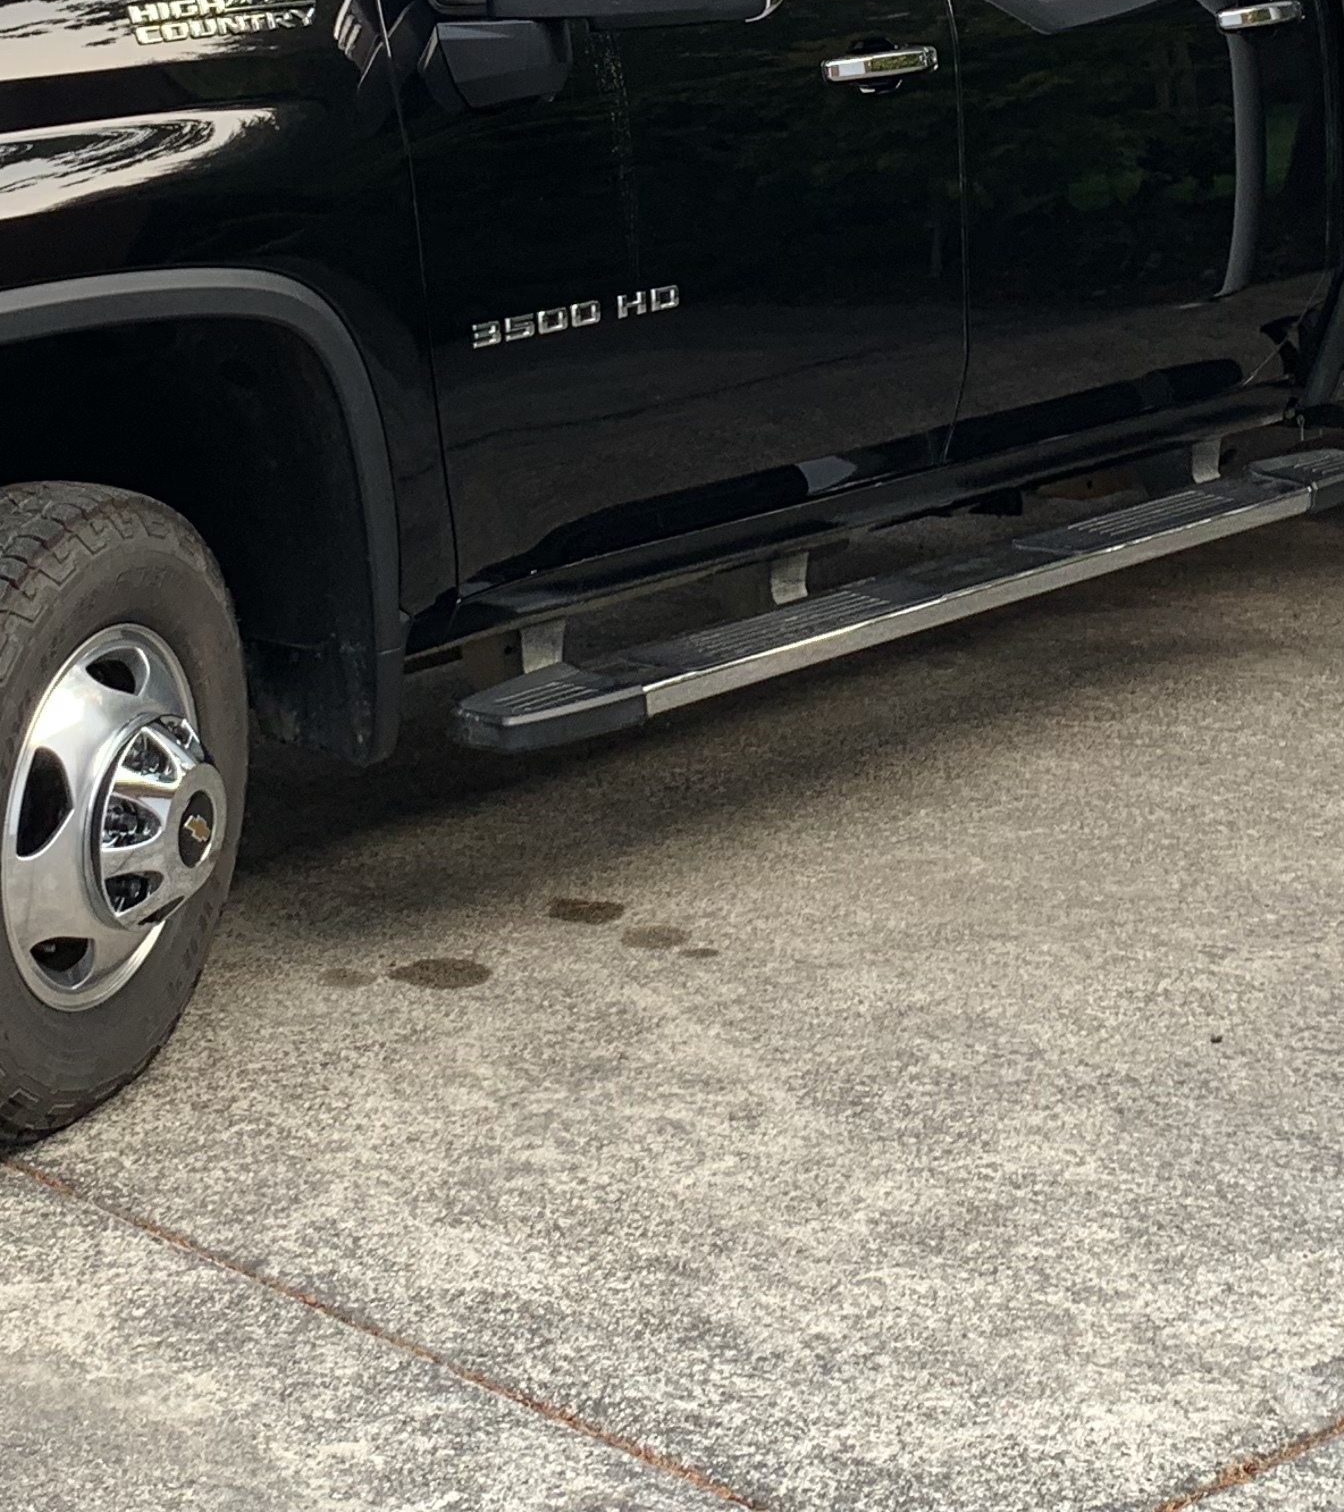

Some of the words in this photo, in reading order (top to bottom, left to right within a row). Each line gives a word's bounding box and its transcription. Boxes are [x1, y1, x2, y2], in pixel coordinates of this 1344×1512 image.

[133, 6, 316, 45] COUNTRY
[472, 299, 602, 349] 3500
[616, 284, 680, 320] HD
